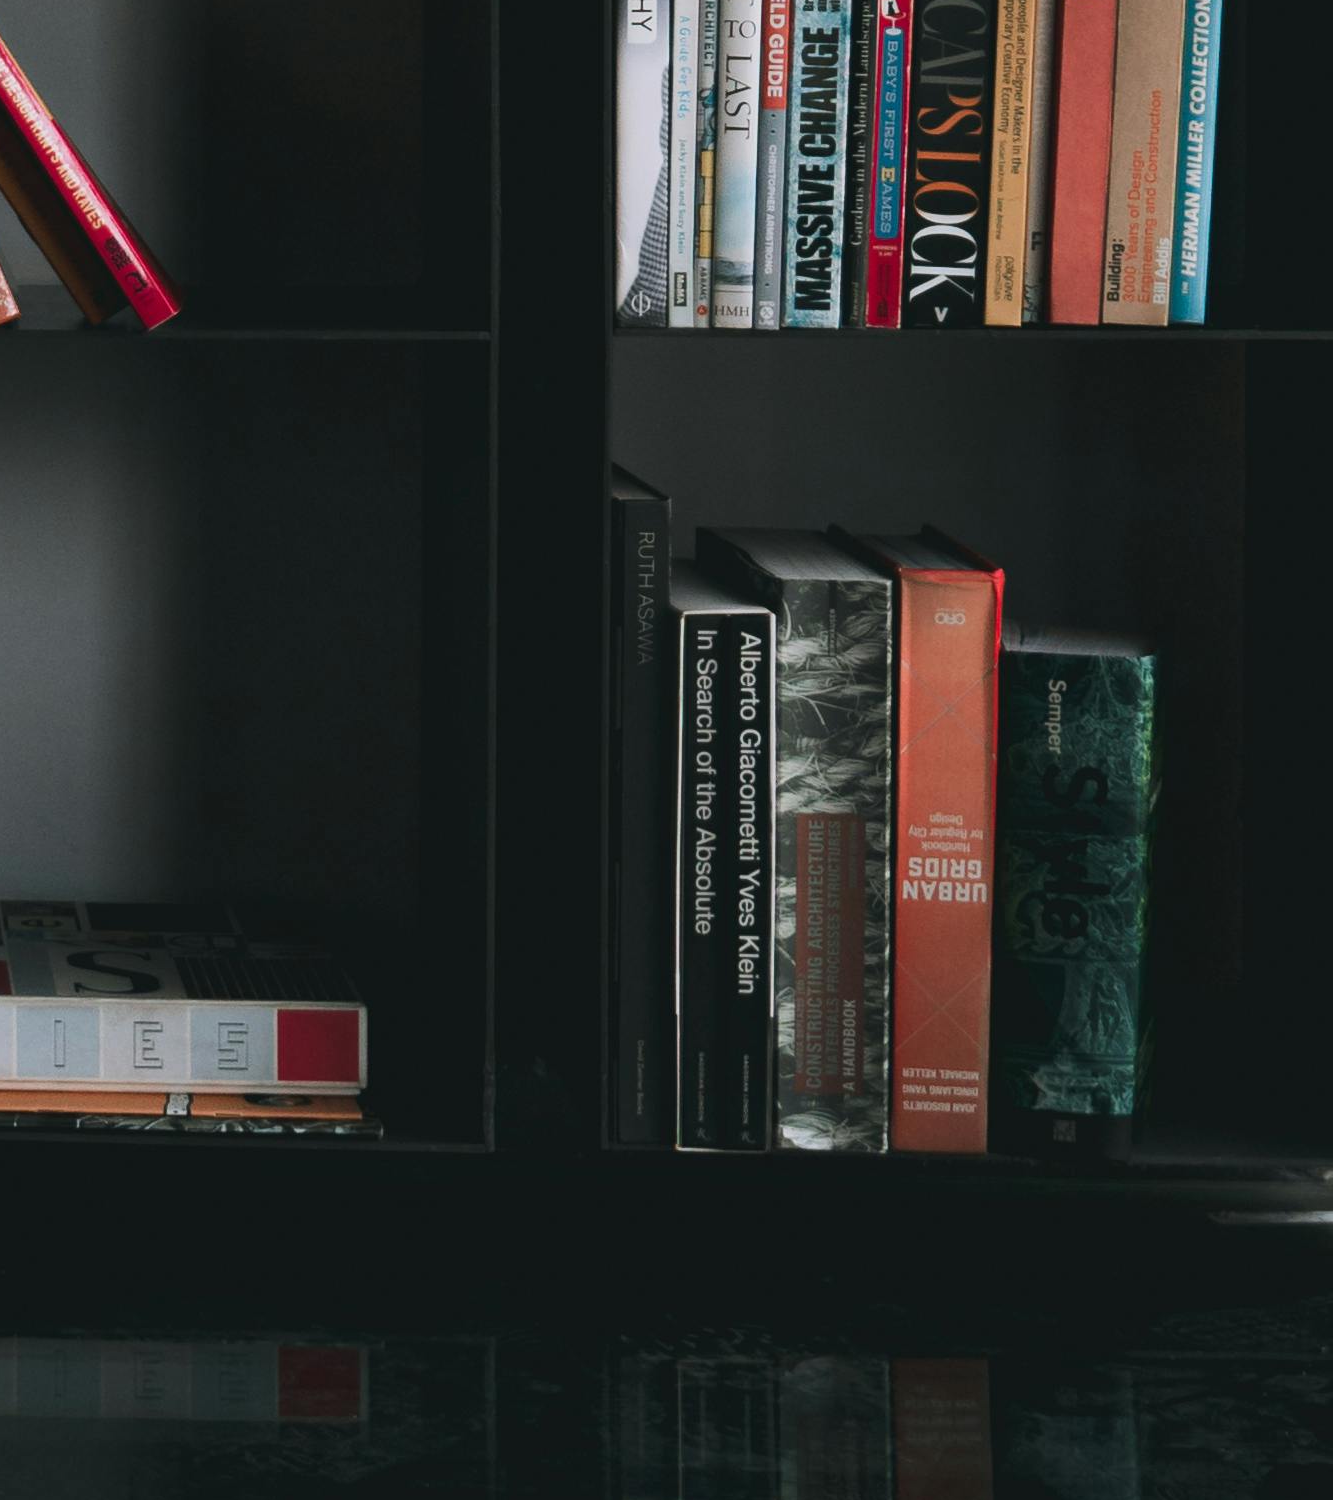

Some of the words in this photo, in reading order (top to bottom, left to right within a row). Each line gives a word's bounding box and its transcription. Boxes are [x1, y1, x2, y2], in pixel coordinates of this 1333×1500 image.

[725, 18, 756, 38] TO
[724, 54, 753, 140] LAST
[802, 28, 838, 157] CHANGE
[796, 166, 832, 311] MASSIVE
[908, 149, 981, 303] LOCK
[697, 629, 718, 649] In
[696, 658, 718, 743] Search
[739, 632, 762, 722] Alberto
[1046, 679, 1067, 754] Semper
[696, 750, 717, 775] of
[738, 728, 762, 861] Giacometti
[695, 783, 717, 820] the
[695, 827, 717, 935] Absolute
[737, 868, 761, 927] Yves
[902, 880, 987, 902] URBAN
[908, 857, 982, 879] GRIDS
[737, 934, 759, 995] Klein
